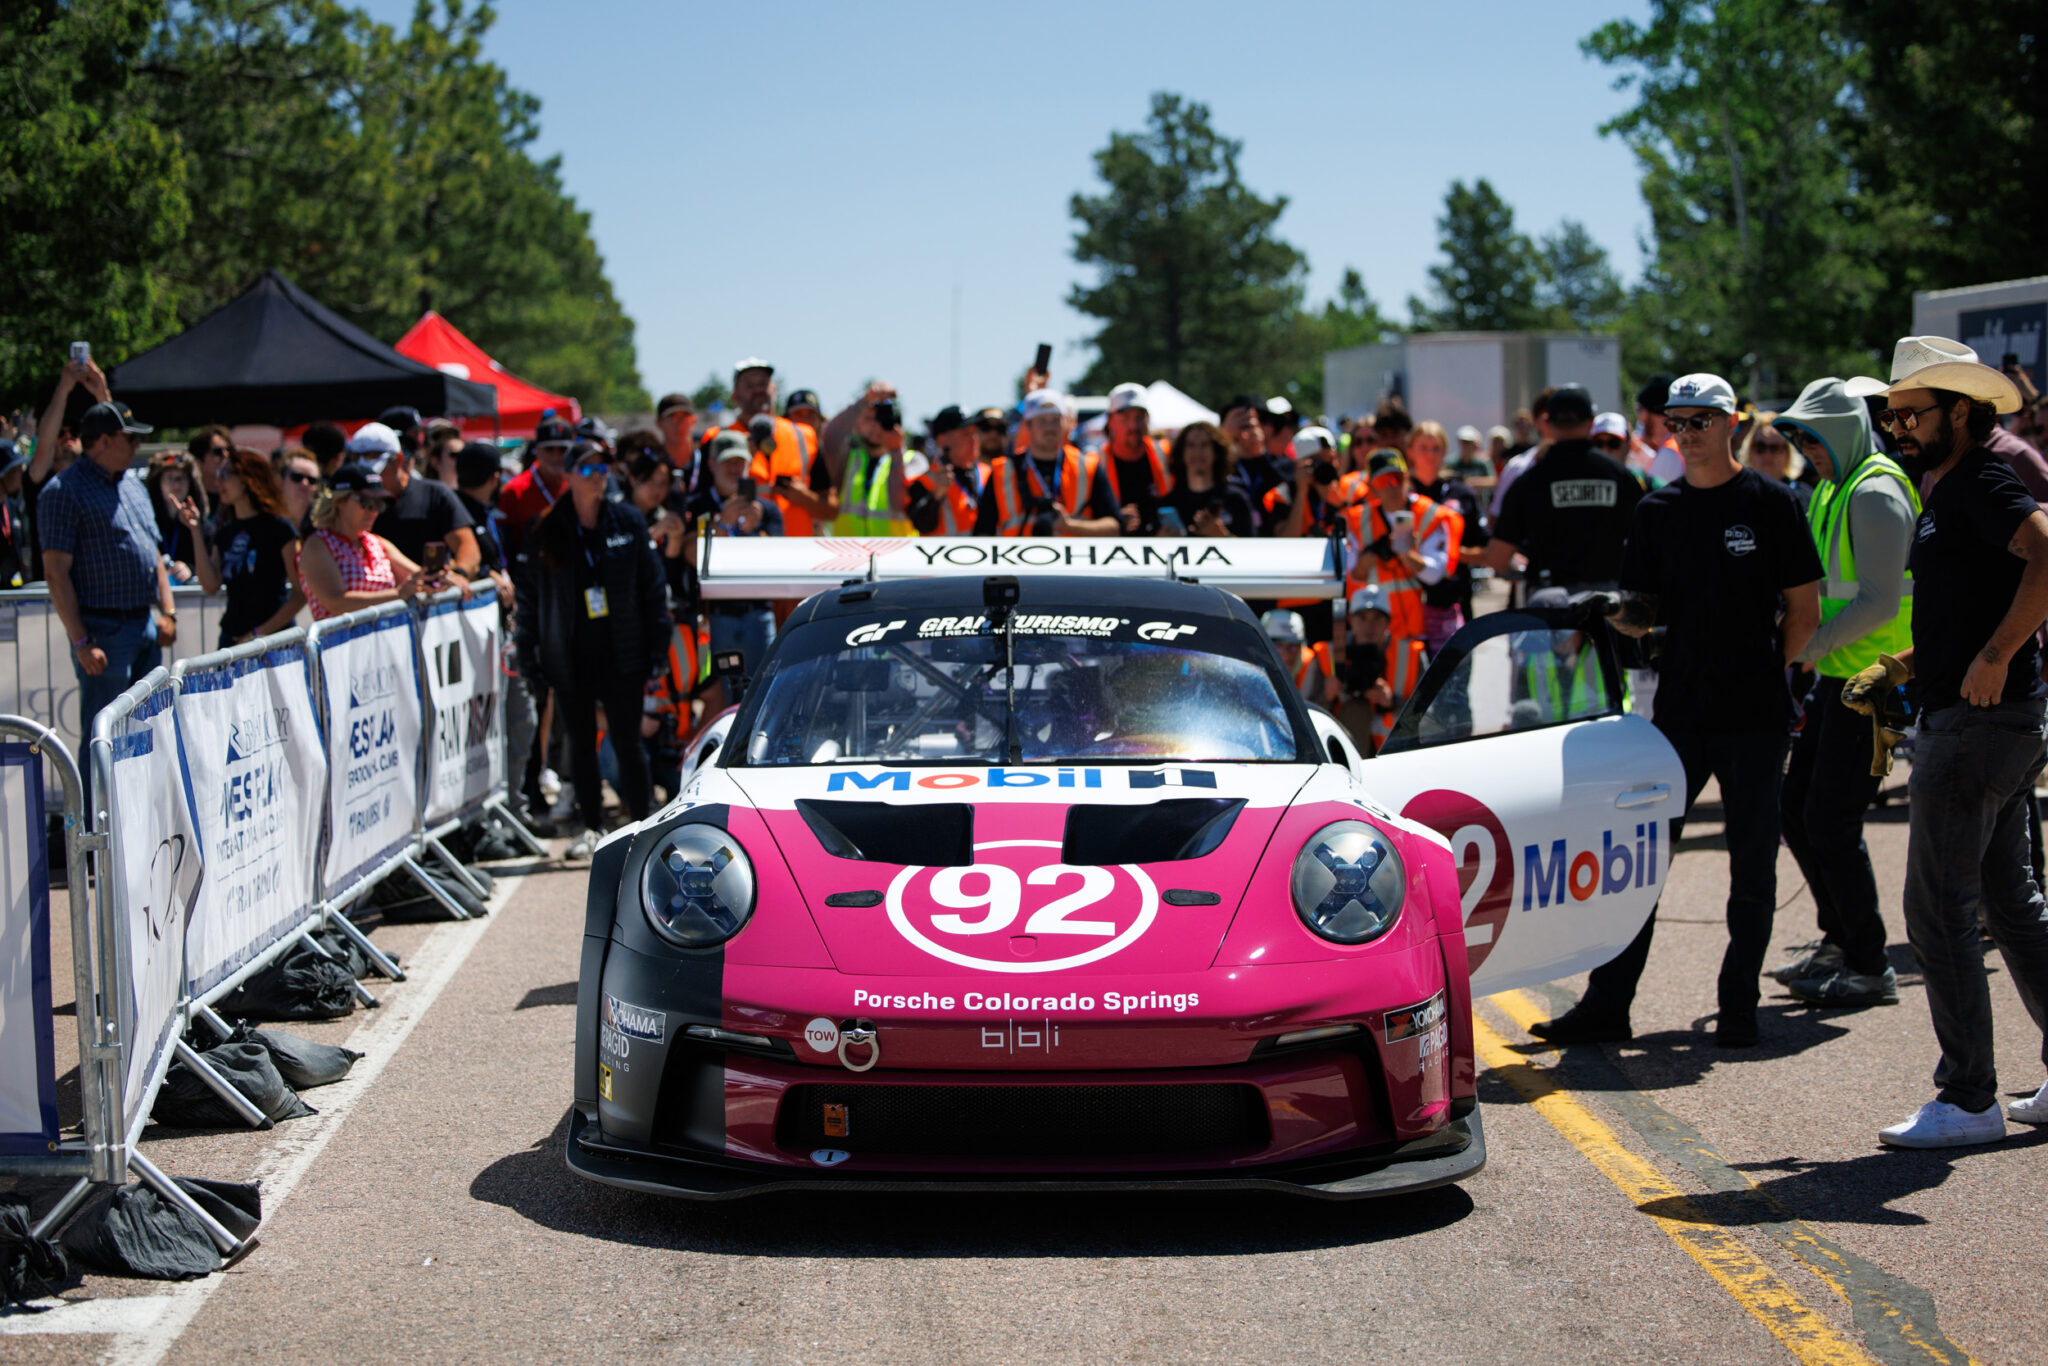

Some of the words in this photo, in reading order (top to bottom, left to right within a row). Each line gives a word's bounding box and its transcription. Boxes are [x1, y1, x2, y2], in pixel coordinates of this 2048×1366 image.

[915, 545, 1232, 566] YOKOHAMA
[945, 629, 979, 637] REAL
[1036, 628, 1111, 637] SIMULATOR
[826, 768, 1102, 792] Mobil
[1523, 822, 1657, 912] Mobil
[929, 864, 1116, 937] 92
[854, 990, 955, 1010] Porsche
[963, 992, 1096, 1010] Colorado
[1103, 991, 1199, 1014] Springs
[807, 1029, 835, 1042] TOW
